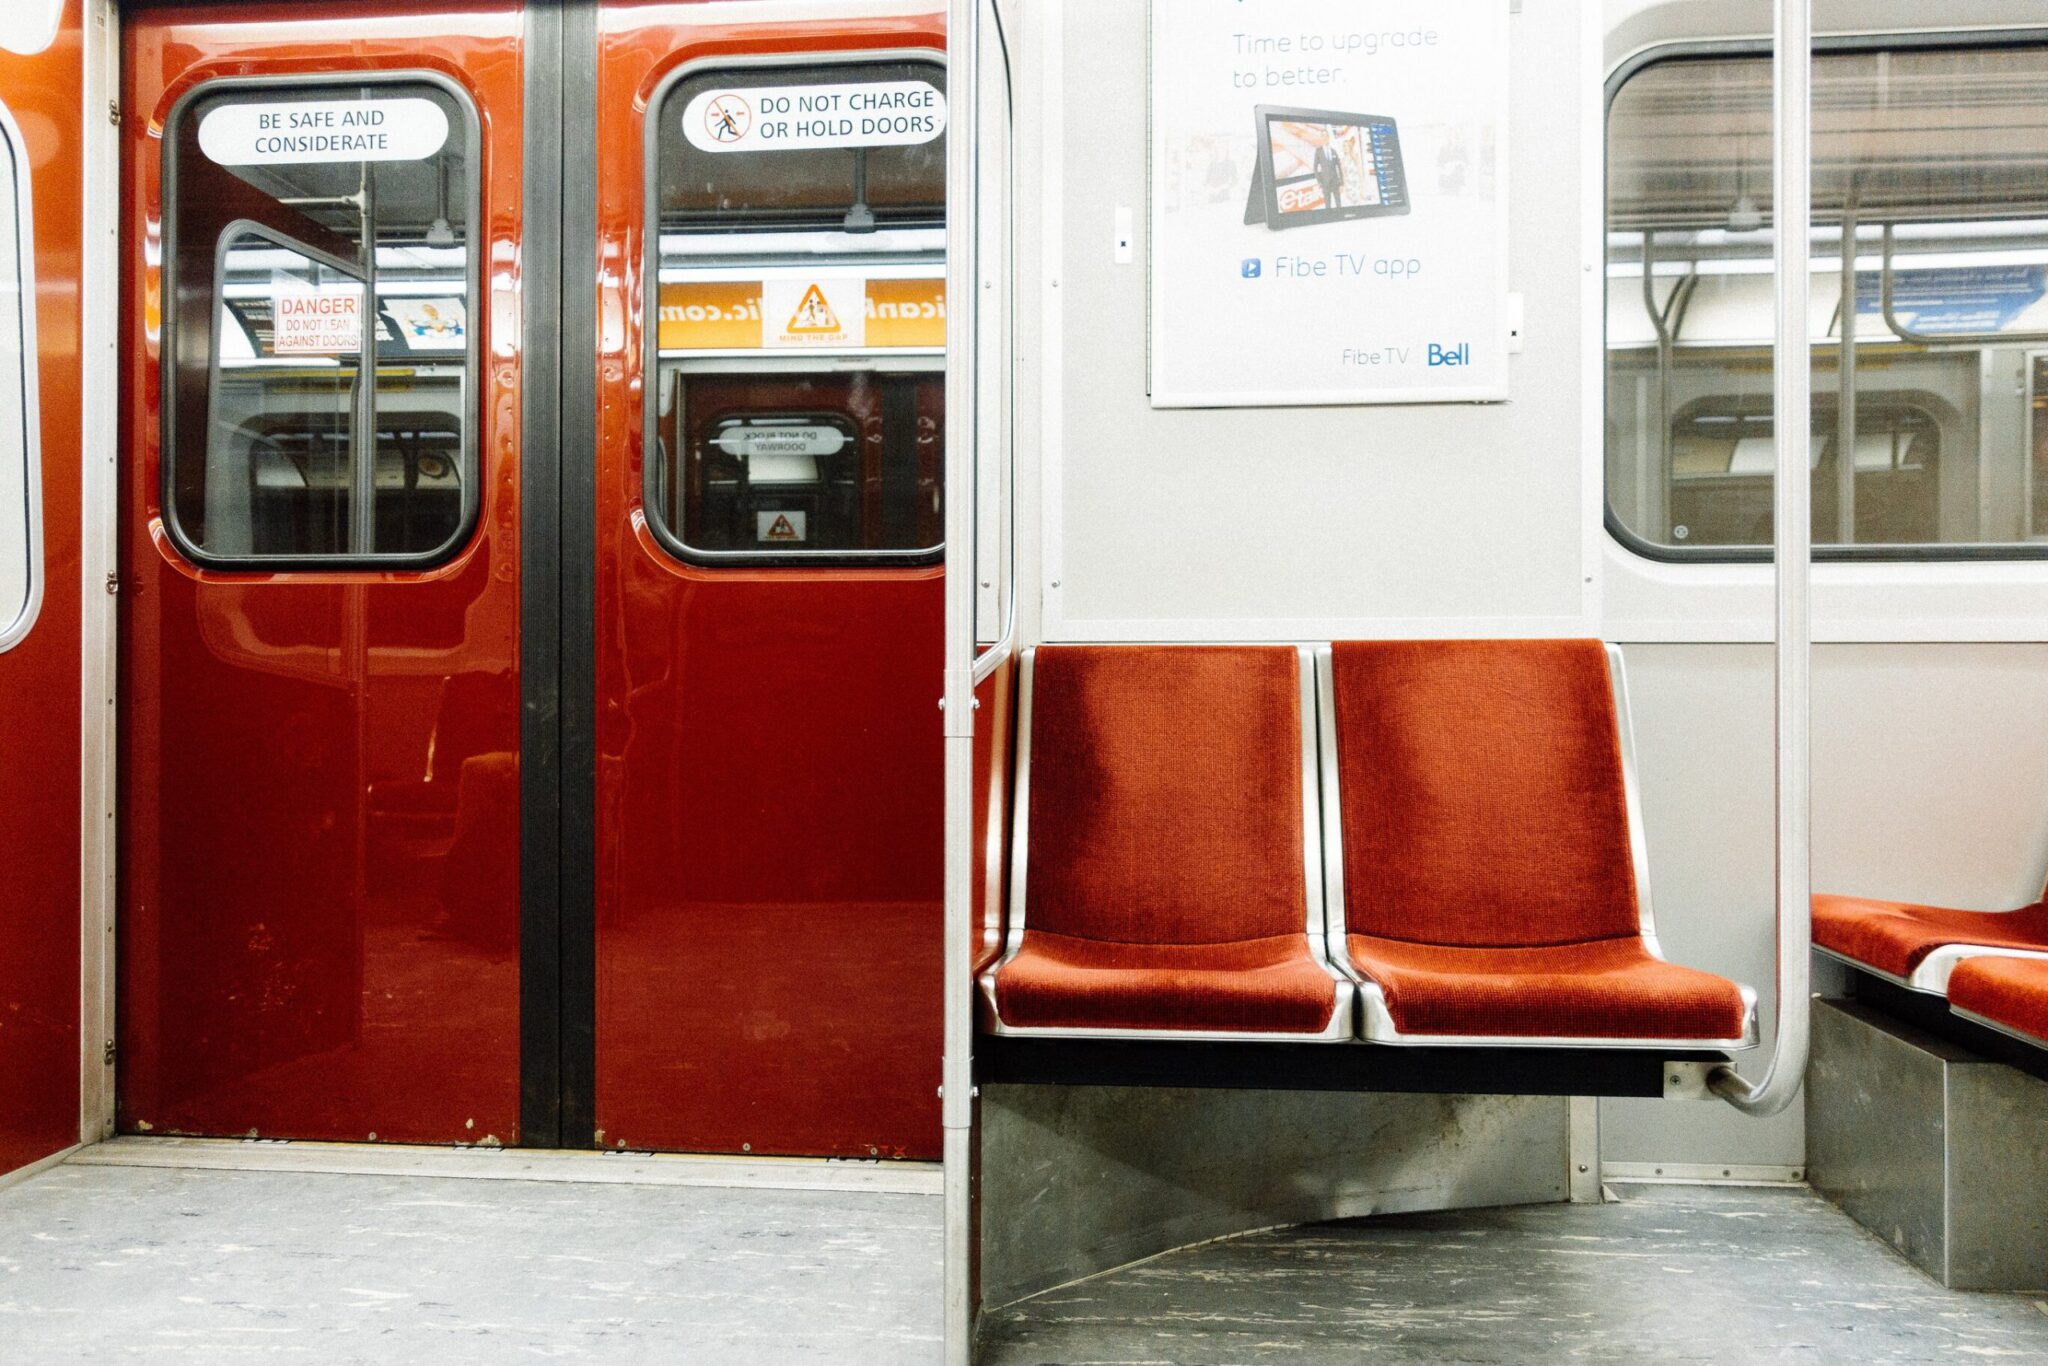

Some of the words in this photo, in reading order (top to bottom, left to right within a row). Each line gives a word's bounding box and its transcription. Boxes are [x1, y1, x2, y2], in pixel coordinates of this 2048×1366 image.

[1232, 33, 1291, 54] Time
[1299, 34, 1324, 52] to
[1332, 27, 1439, 56] upgrade
[1233, 69, 1257, 88] to
[1265, 66, 1347, 87] better.
[760, 96, 790, 114] DO
[799, 94, 841, 112] NOT
[849, 90, 935, 110] CHARGE
[259, 113, 281, 129] BE
[289, 111, 334, 128] SAFE
[341, 110, 385, 126] AND
[760, 122, 788, 139] OR
[796, 119, 853, 137] HOLD
[861, 115, 935, 135] DOORS
[255, 133, 388, 153] CONSIDERATE
[1275, 256, 1327, 277] Fibe
[1335, 254, 1366, 276] TV
[1373, 257, 1421, 280] app
[281, 297, 356, 315] DANGER
[286, 319, 300, 331] DO
[303, 319, 321, 331] NOT
[279, 335, 321, 347] AGAINST
[322, 334, 357, 347] DOORS
[1342, 348, 1381, 365] Fibe
[1384, 347, 1410, 364] TV
[1427, 343, 1469, 366] Bell
